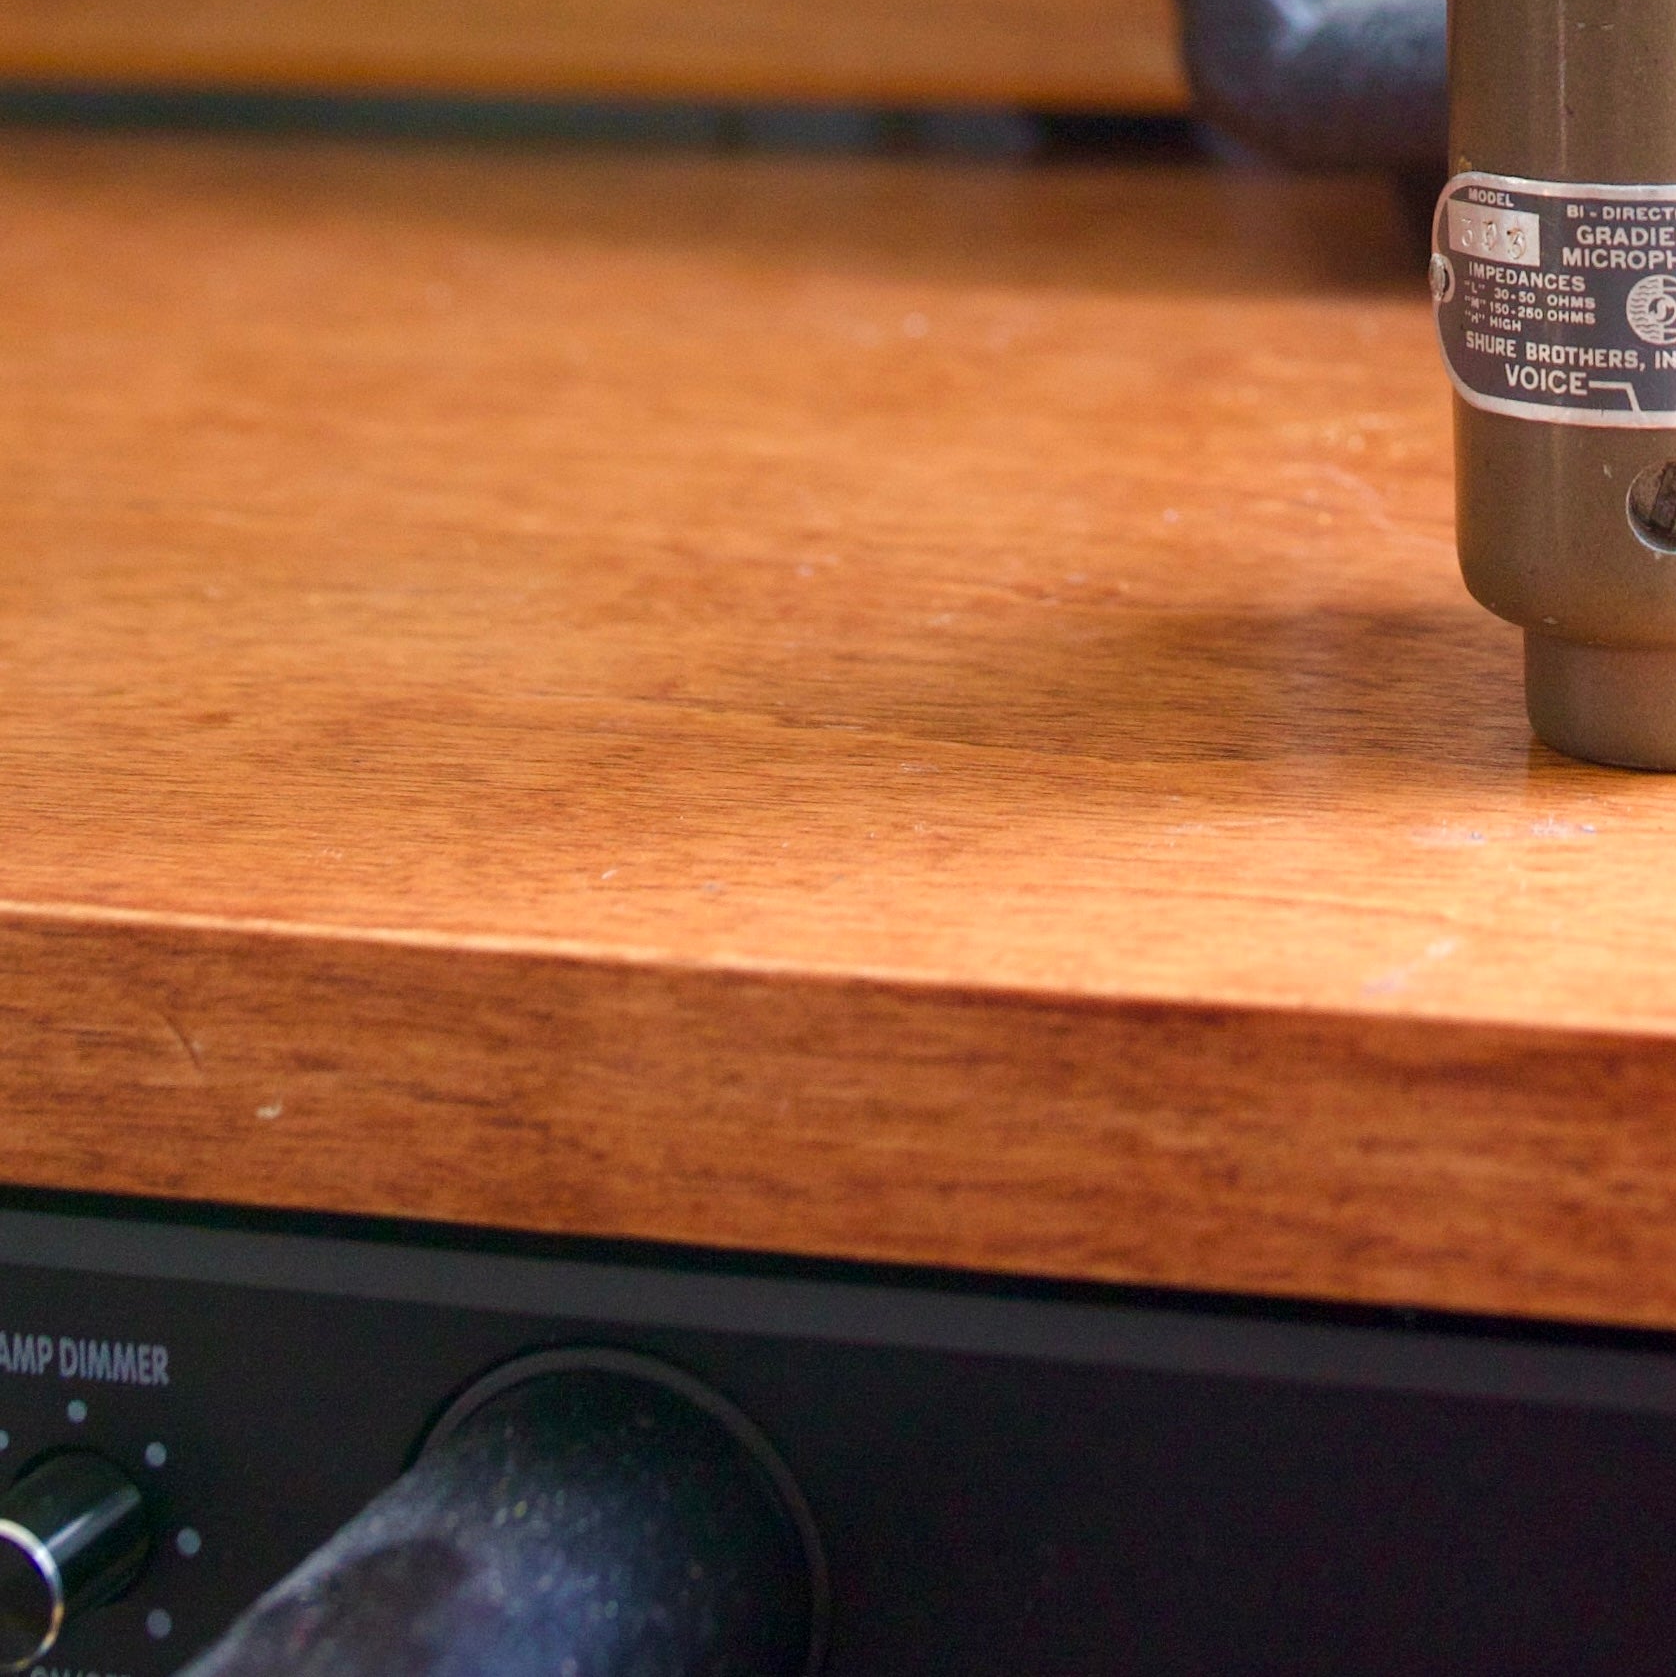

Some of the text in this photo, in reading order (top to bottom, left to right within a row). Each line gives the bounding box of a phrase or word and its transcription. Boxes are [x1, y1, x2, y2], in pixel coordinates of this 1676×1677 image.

[1468, 187, 1514, 207] MODEL
[1468, 261, 1586, 292] IMPEDANCES
[1547, 294, 1596, 309] OHMS
[1489, 316, 1522, 333] HIGH
[1547, 310, 1596, 325] OHMS
[1465, 331, 1517, 358] SHURE
[1526, 342, 1646, 371] BROTHERS,
[1505, 363, 1588, 396] VOICE
[59, 1335, 170, 1386] DIMMER
